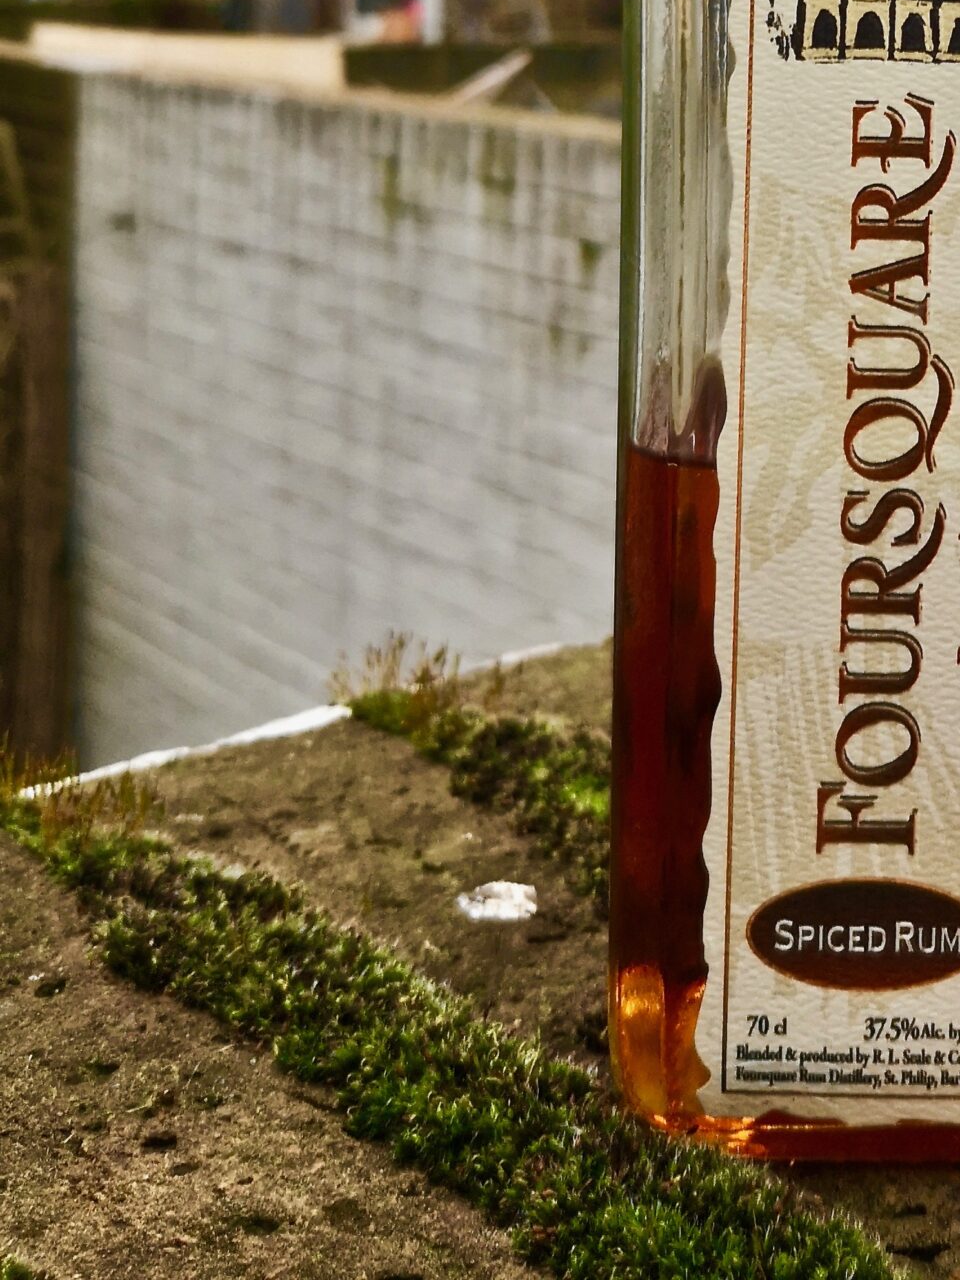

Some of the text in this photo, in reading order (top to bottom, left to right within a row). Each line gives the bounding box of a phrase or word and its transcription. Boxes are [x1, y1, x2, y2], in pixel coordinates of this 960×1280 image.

[816, 92, 957, 855] FOURSQUARE
[774, 919, 887, 953] SPICED
[747, 1015, 769, 1037] 70
[864, 1017, 919, 1041] 37.5%
[736, 1043, 782, 1061] Blended
[786, 1047, 797, 1061] &
[800, 1046, 853, 1067] produced
[856, 1047, 870, 1068] by
[873, 1048, 885, 1064] R.
[888, 1048, 899, 1065] L.
[902, 1048, 931, 1065] Seale
[934, 1050, 945, 1065] &
